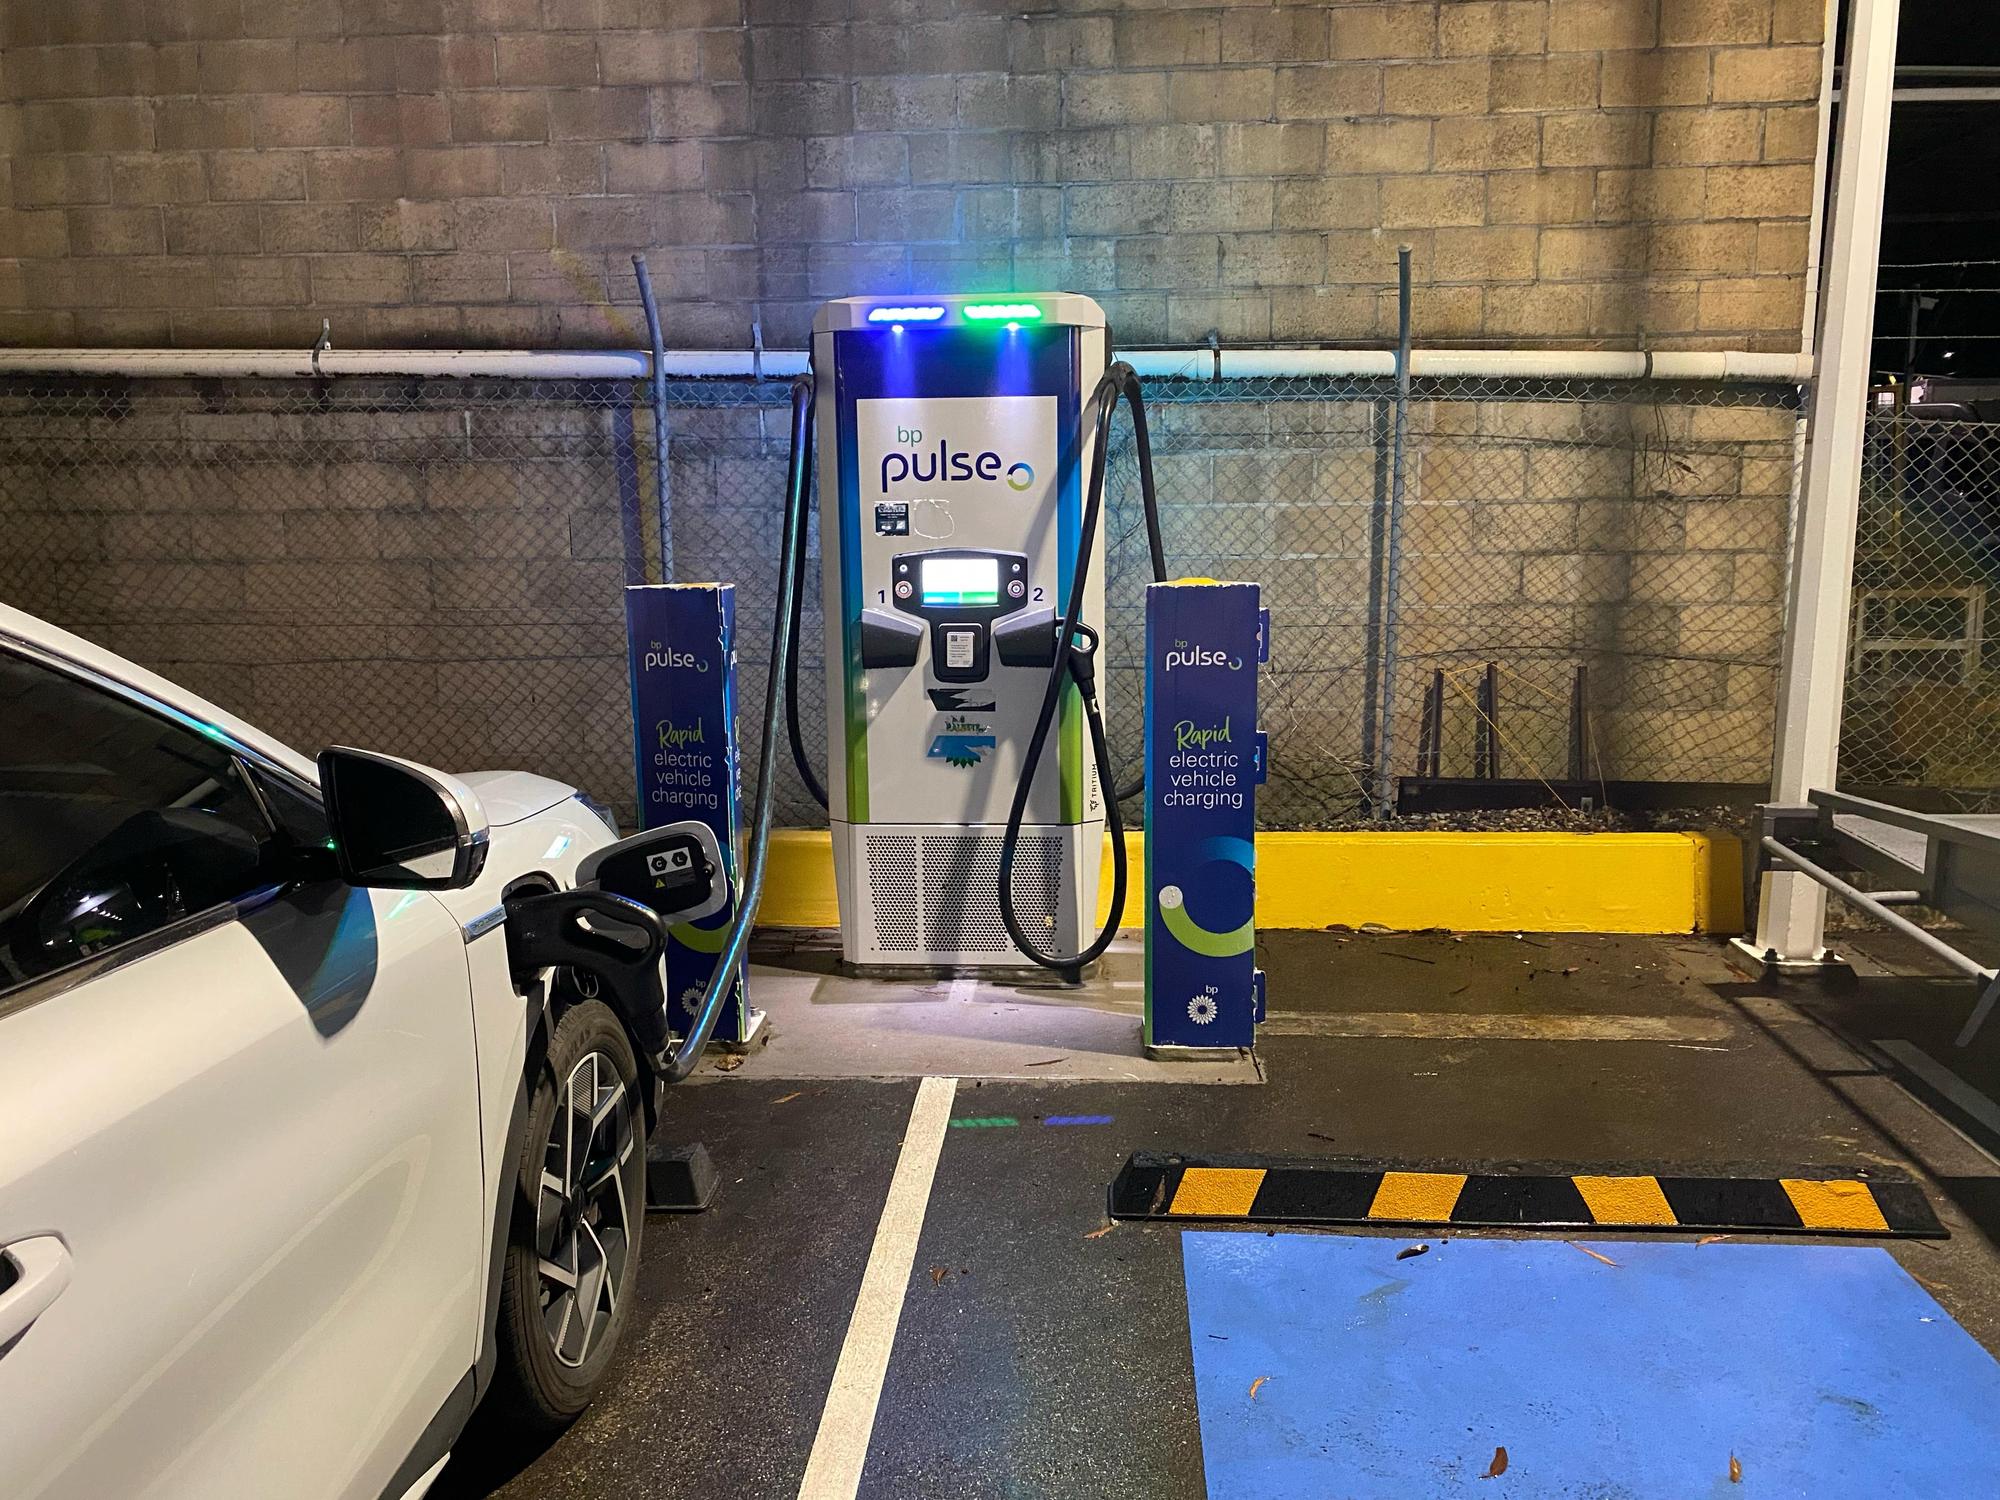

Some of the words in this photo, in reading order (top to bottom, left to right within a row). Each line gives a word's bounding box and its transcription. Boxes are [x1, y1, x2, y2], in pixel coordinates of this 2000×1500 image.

[897, 425, 923, 447] bp
[881, 439, 1001, 493] pulse
[877, 589, 886, 604] 1
[1033, 587, 1044, 602] 2
[1174, 639, 1188, 649] bp
[645, 647, 695, 671] pulse
[1166, 645, 1227, 671] pulse
[655, 716, 705, 750] Rapid
[1173, 715, 1232, 751] Rapid
[654, 750, 712, 768] electric
[1169, 750, 1239, 768] electric
[656, 769, 711, 787] vehicle
[1170, 770, 1237, 787] vehicle
[652, 787, 718, 810] charging
[1163, 789, 1243, 810] charging
[1205, 984, 1218, 995] bp
